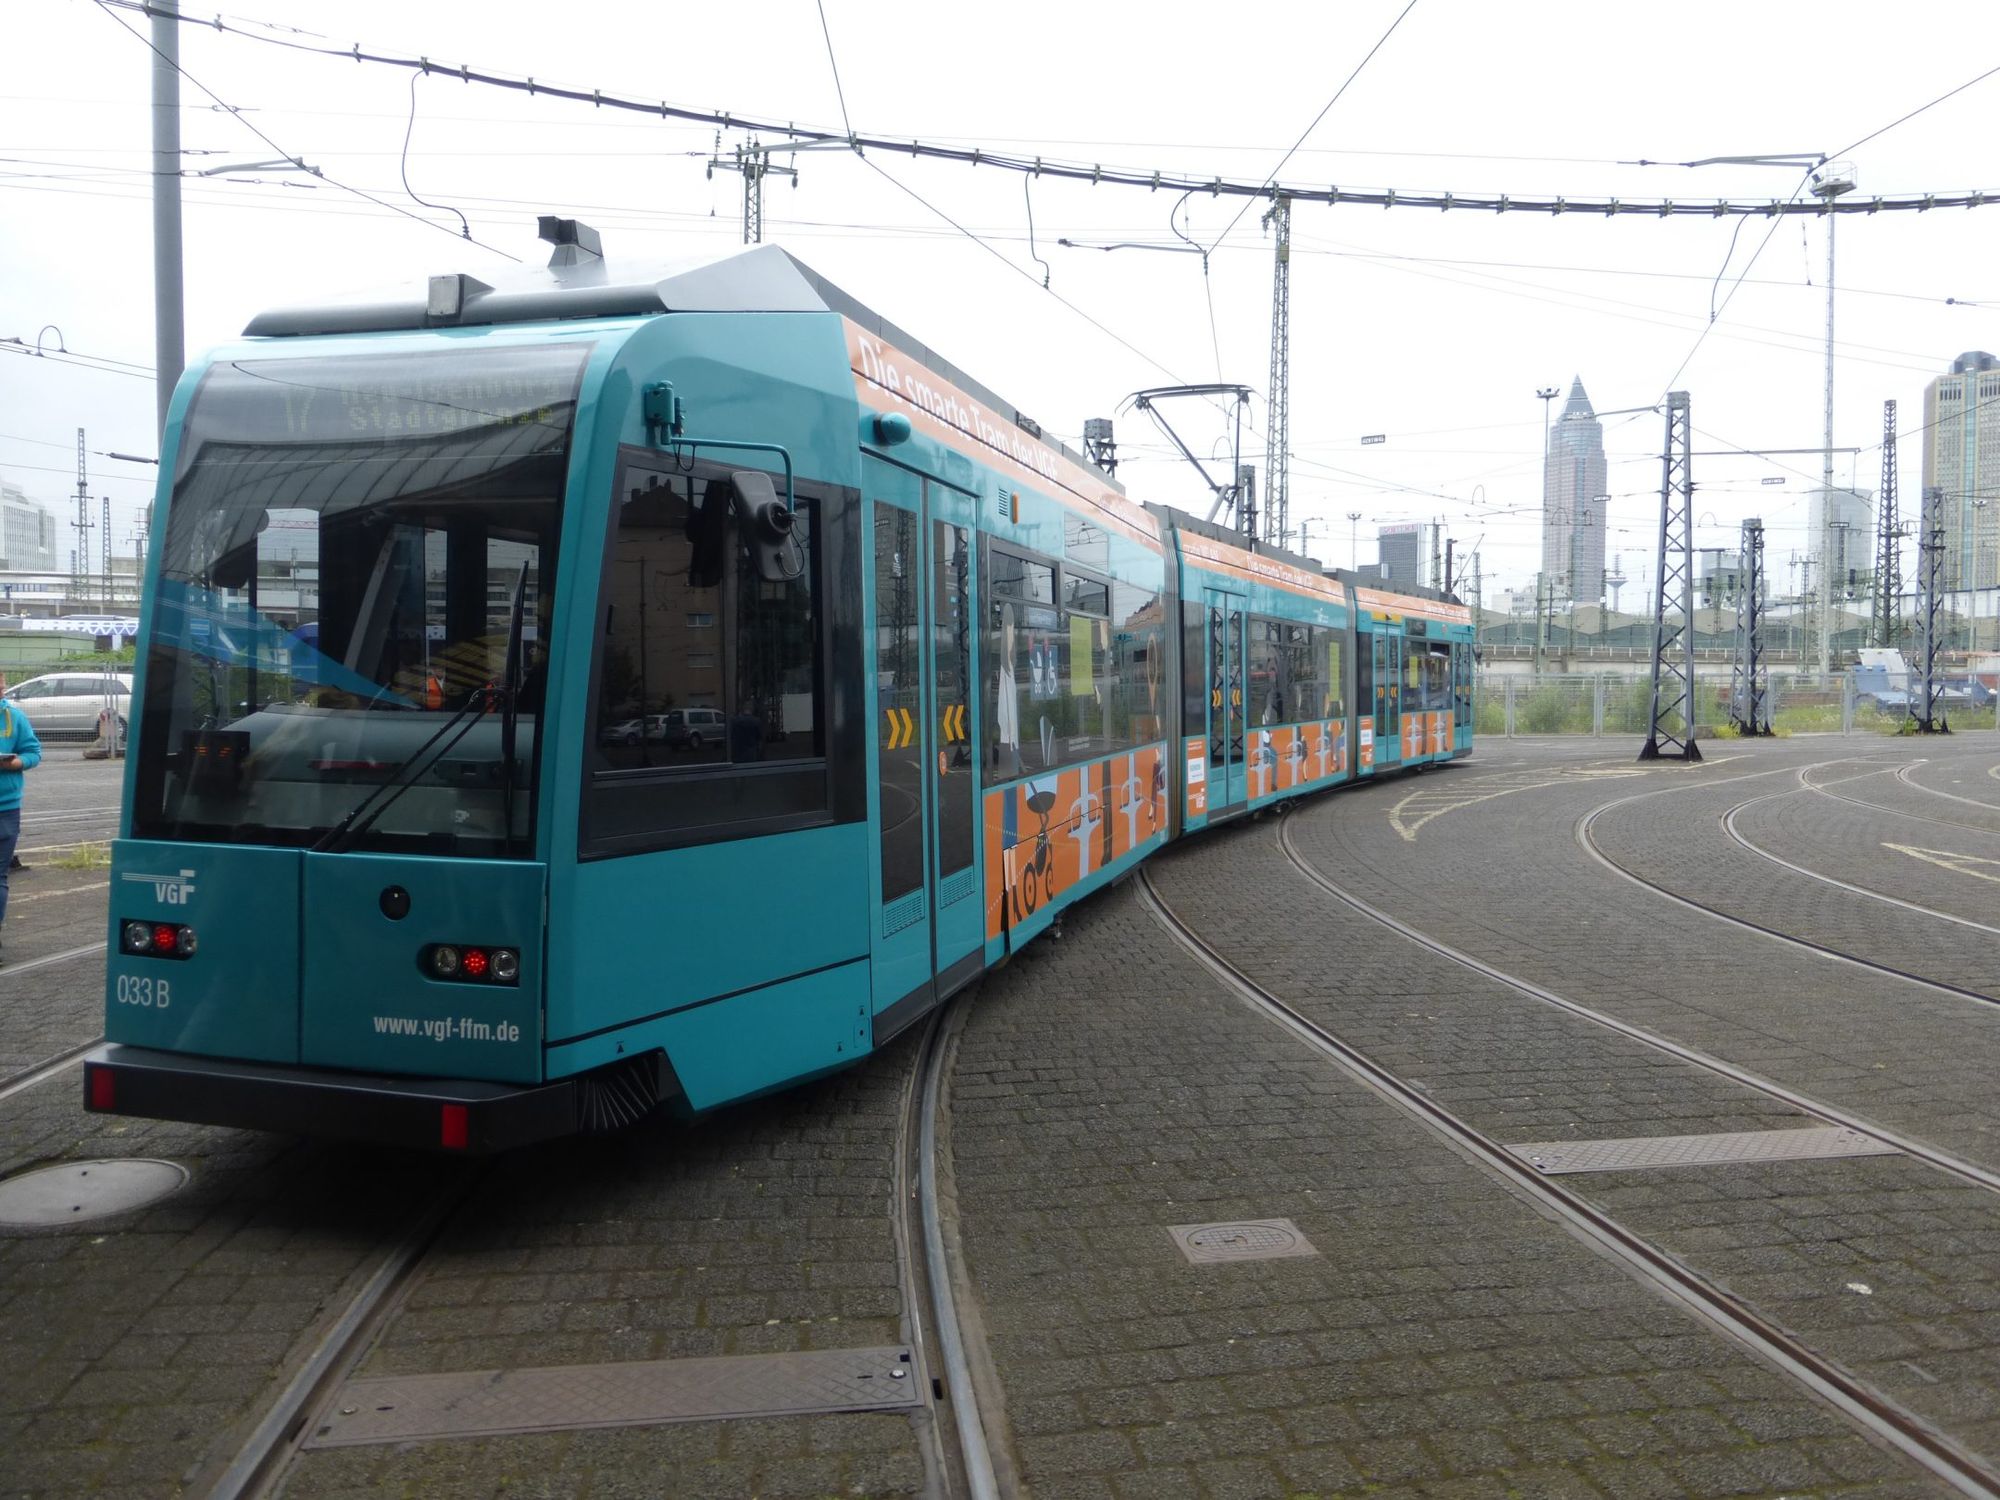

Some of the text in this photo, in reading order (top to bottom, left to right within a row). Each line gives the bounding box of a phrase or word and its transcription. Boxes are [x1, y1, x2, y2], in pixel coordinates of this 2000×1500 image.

[281, 387, 317, 432] 17
[857, 335, 902, 404] Die
[905, 374, 970, 441] smarte
[969, 403, 1013, 464] Tram
[1013, 430, 1034, 475] der
[155, 869, 195, 905] VGF
[117, 974, 170, 1008] 033 B
[373, 1016, 520, 1042] www.vgf-ffm.de
